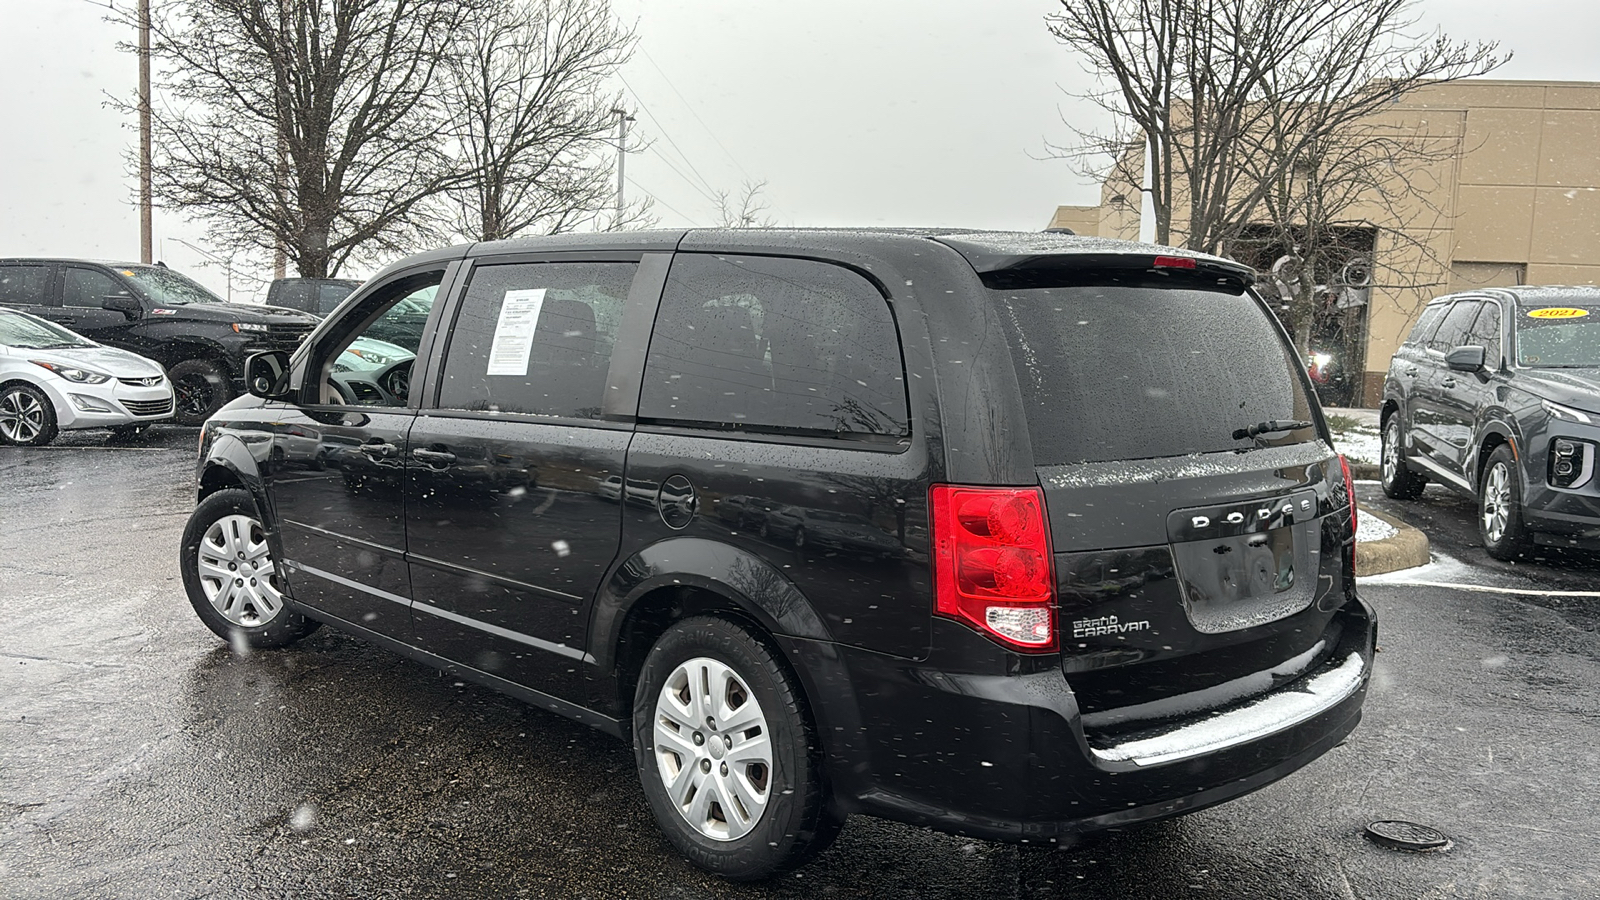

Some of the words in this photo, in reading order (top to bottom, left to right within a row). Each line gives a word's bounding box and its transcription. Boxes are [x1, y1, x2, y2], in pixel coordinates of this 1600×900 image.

[1538, 309, 1578, 318] 2021
[1191, 499, 1311, 529] DODGE
[1072, 616, 1118, 629] GRAND
[1073, 620, 1150, 638] CARAVAN
